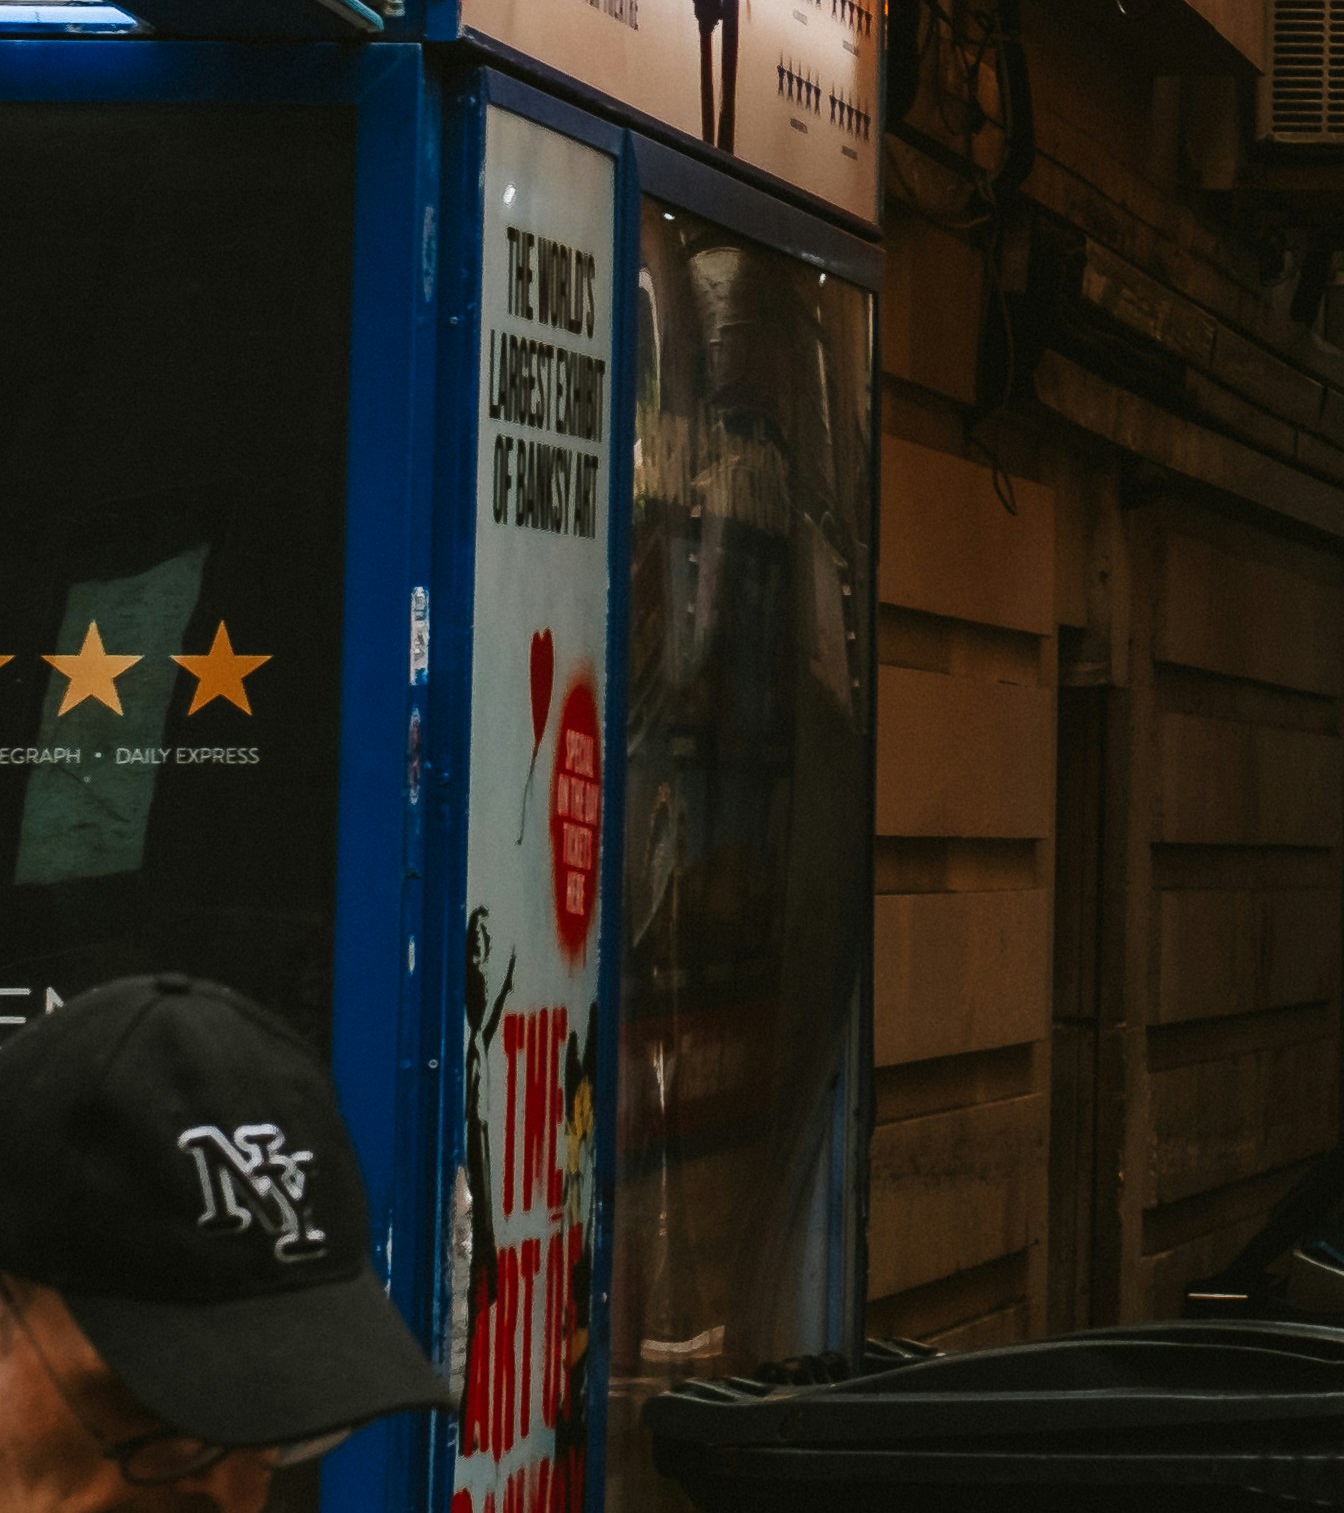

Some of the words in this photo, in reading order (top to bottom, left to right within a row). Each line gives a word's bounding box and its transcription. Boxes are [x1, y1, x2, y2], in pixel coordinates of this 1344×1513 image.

[507, 226, 535, 321] THE
[538, 236, 596, 340] WORLD'S
[489, 328, 555, 431] LARGEST
[493, 433, 514, 526] OF
[516, 438, 573, 536] BANKSY
[573, 451, 599, 540] ART
[115, 746, 172, 765] DAILY
[176, 746, 261, 765] EXPRESS
[503, 1007, 568, 1215] THE
[464, 1235, 541, 1462] ART
